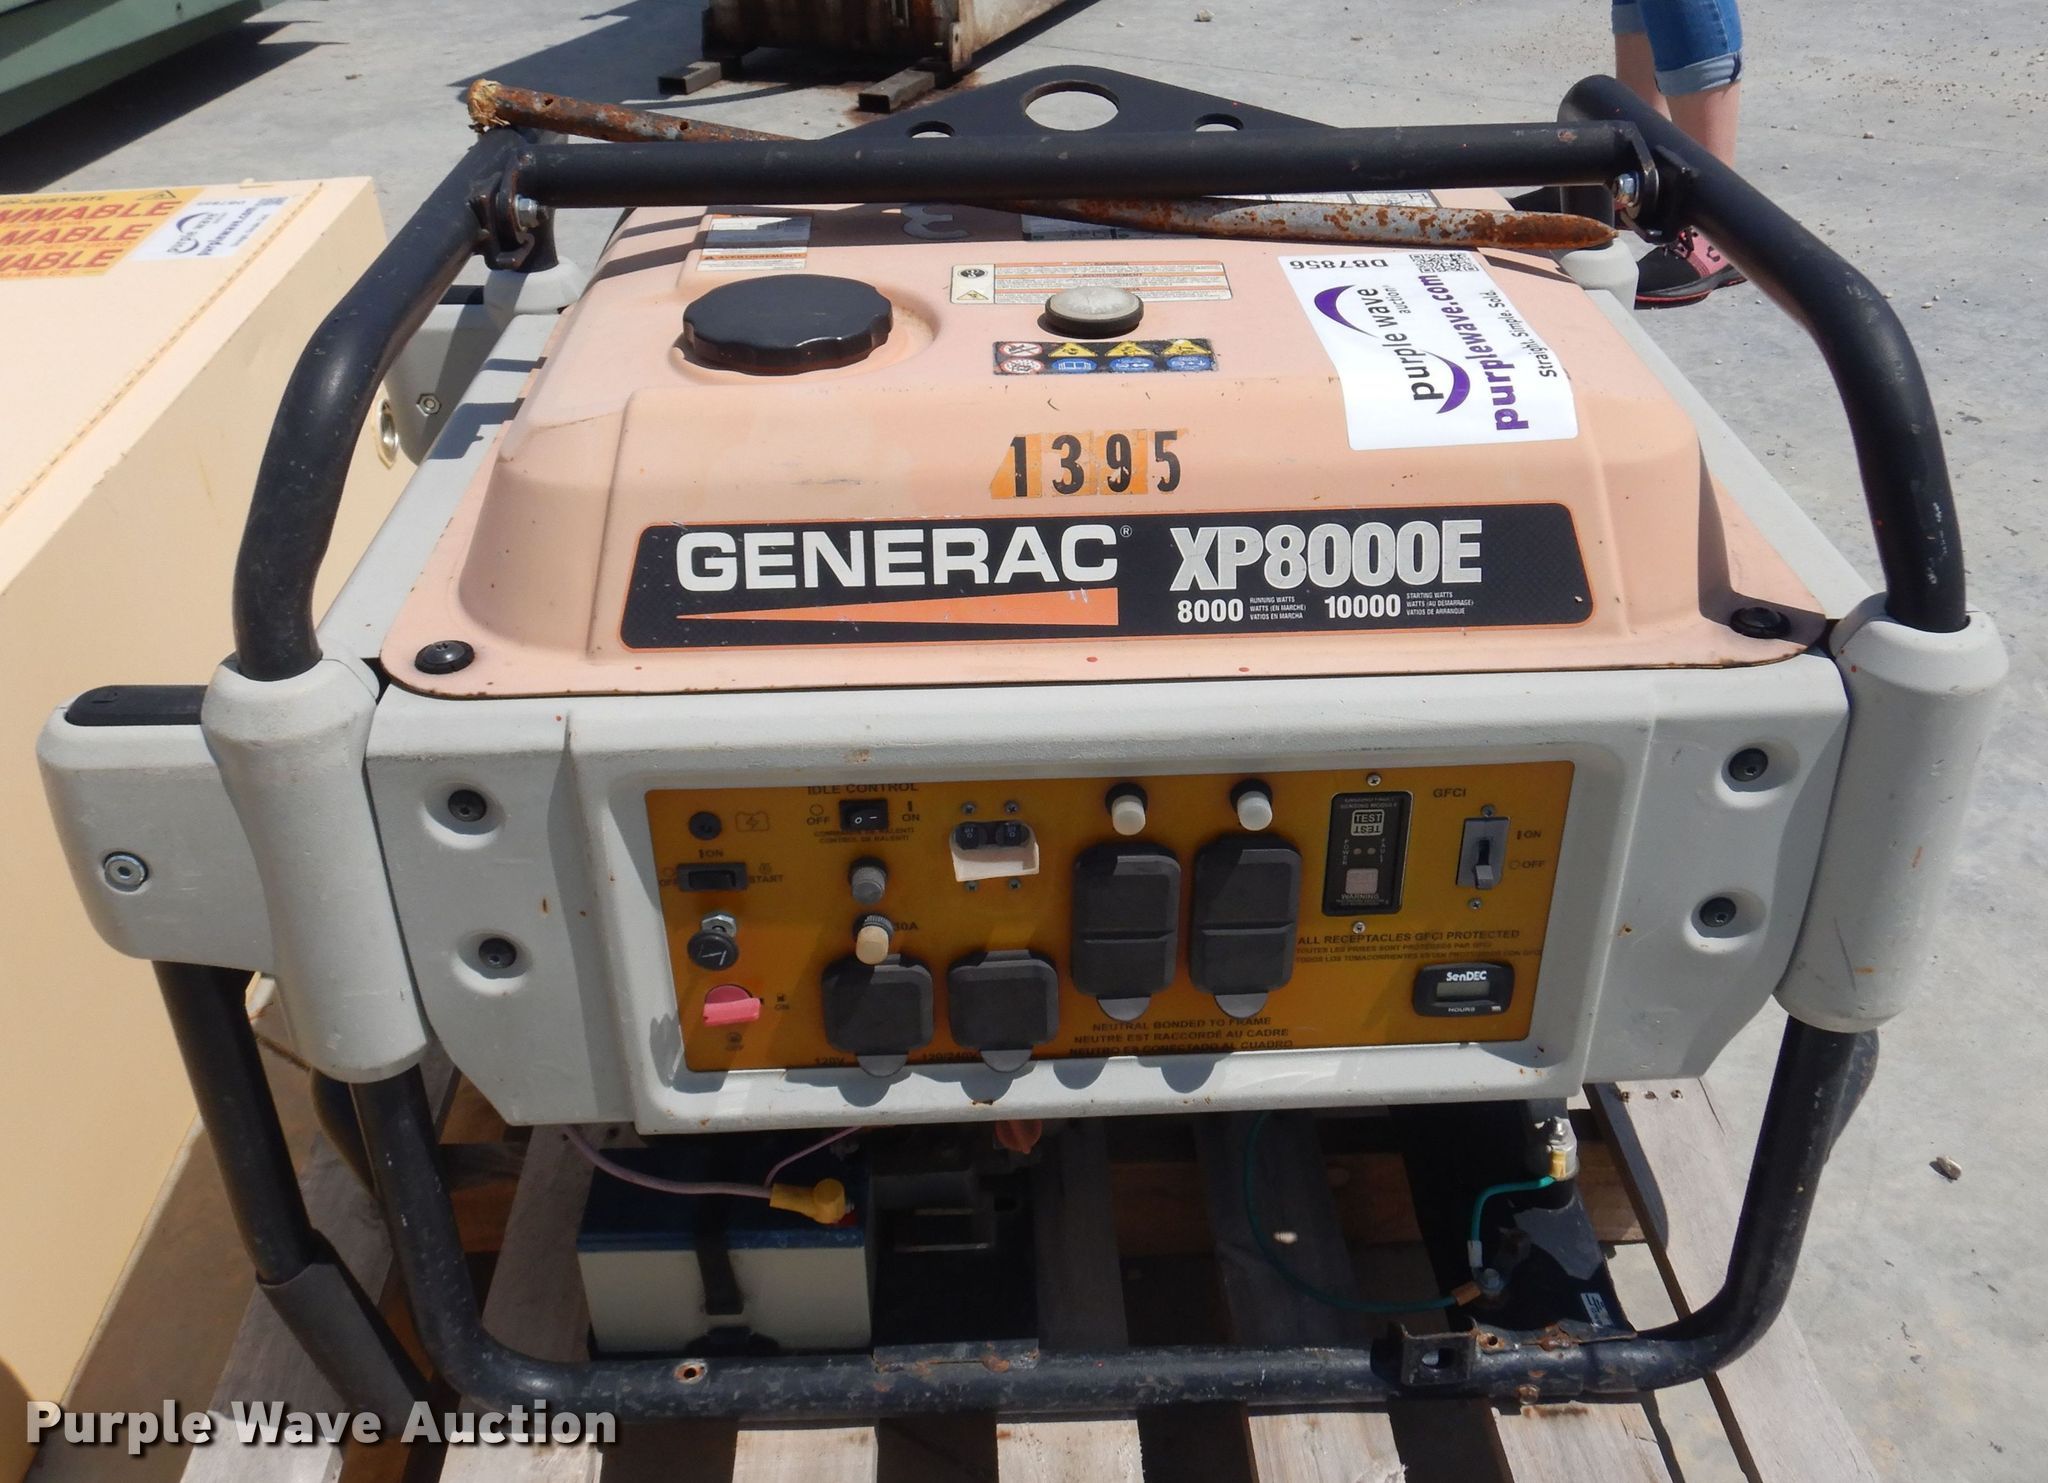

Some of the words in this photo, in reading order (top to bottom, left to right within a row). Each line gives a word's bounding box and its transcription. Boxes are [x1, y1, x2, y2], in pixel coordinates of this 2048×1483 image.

[1288, 258, 1389, 270] DB7856
[1357, 288, 1398, 328] wave
[1418, 274, 1529, 431] purplewave.com
[1381, 333, 1445, 401] purple
[1009, 430, 1182, 498] 1395
[675, 523, 1119, 592] GENERAC
[1168, 518, 1483, 592] XP8000E
[1177, 598, 1244, 623] 8000
[1324, 593, 1400, 619] 10000
[807, 785, 841, 795] IDLE
[846, 782, 920, 794] CONTROL
[1432, 786, 1467, 799] GFCI
[806, 815, 831, 826] OFF
[901, 813, 920, 822] ON
[1355, 813, 1382, 823] TEST
[1353, 825, 1381, 834] TEST
[1523, 829, 1542, 839] ON
[1521, 859, 1545, 869] OFF
[1297, 936, 1321, 945] ALL
[1323, 932, 1412, 944] RECEPTACLES
[1414, 931, 1444, 941] GFCI
[1446, 929, 1520, 940] PROTECTED
[1445, 970, 1488, 982] SenDEC
[1093, 1021, 1149, 1031] NEUTRAL
[1152, 1019, 1206, 1029] BONDED
[1209, 1018, 1226, 1027] TO
[1228, 1016, 1272, 1026] FRAME
[1126, 1032, 1150, 1042] EST
[1225, 1029, 1244, 1038] AU
[1246, 1027, 1289, 1037] CADRE
[1239, 1039, 1294, 1049] CUADRO
